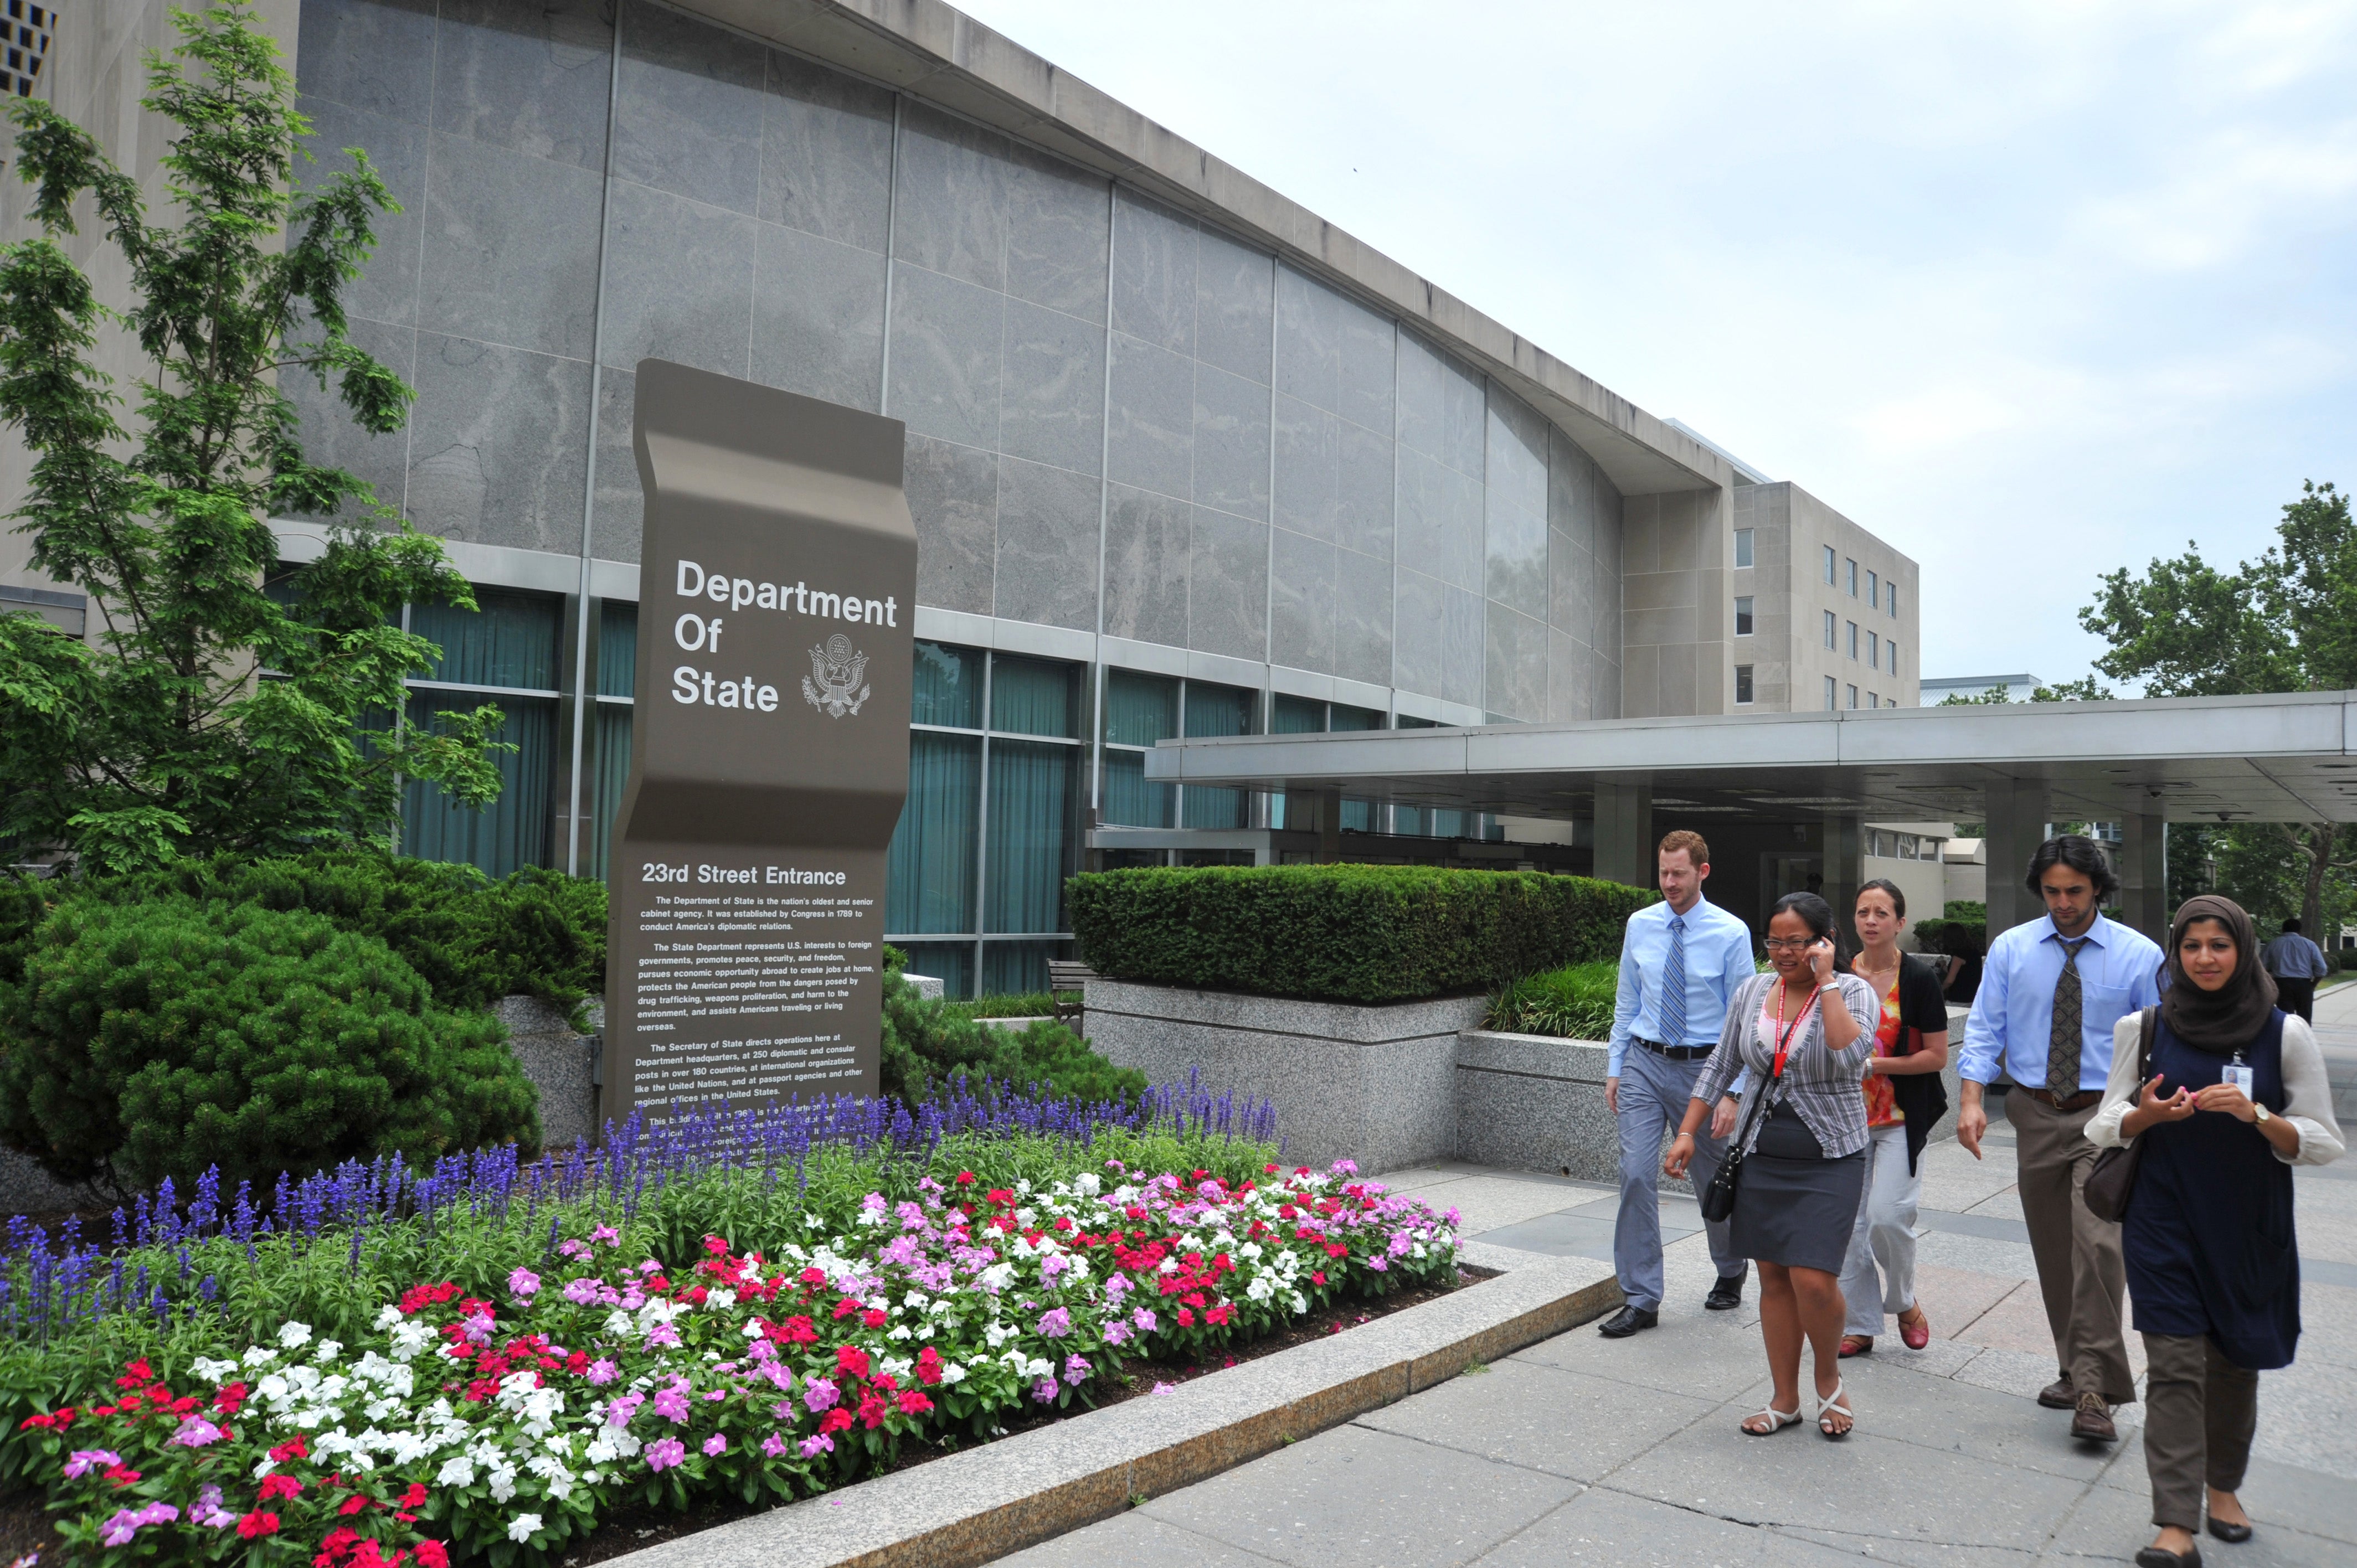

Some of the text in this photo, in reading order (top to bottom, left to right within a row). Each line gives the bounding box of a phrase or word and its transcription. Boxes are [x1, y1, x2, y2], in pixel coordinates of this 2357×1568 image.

[677, 560, 897, 627] Department
[675, 613, 722, 653] Of
[672, 666, 778, 711] State
[642, 863, 846, 885] 23rd Street Entrance
[674, 896, 719, 905] Department
[780, 910, 788, 919] by
[791, 910, 825, 919] Congress
[718, 923, 756, 931] diplomatic
[697, 943, 742, 952] Department
[848, 941, 872, 949] foreign
[639, 957, 693, 966] governments,
[696, 956, 733, 964] promotes
[764, 955, 795, 963] security,
[715, 968, 759, 977] opportunity
[826, 966, 841, 974] jobs
[638, 983, 672, 993] protects
[730, 981, 756, 989] people
[794, 979, 822, 987] dangers
[825, 978, 847, 986] posed
[638, 997, 656, 1005] drug
[660, 996, 702, 1004] trafficking,
[742, 992, 788, 1002] proliferation,
[637, 1009, 688, 1018] environment,
[1799, 1005, 1808, 1017] Central
[669, 1043, 708, 1051] Secretary
[774, 1036, 812, 1045] operations
[636, 1056, 683, 1067] Department
[687, 1054, 739, 1062] headquarters,
[770, 1048, 807, 1058] diplomatic
[635, 1071, 658, 1081] posts
[710, 1065, 747, 1074] countries,
[761, 1060, 805, 1070] international
[808, 1058, 854, 1067] organizations
[669, 1081, 694, 1090] United
[698, 1080, 728, 1088] Nations,
[759, 1074, 791, 1085] passport
[795, 1072, 826, 1081] agencies
[727, 1090, 751, 1098] United
[649, 1117, 666, 1126] This
